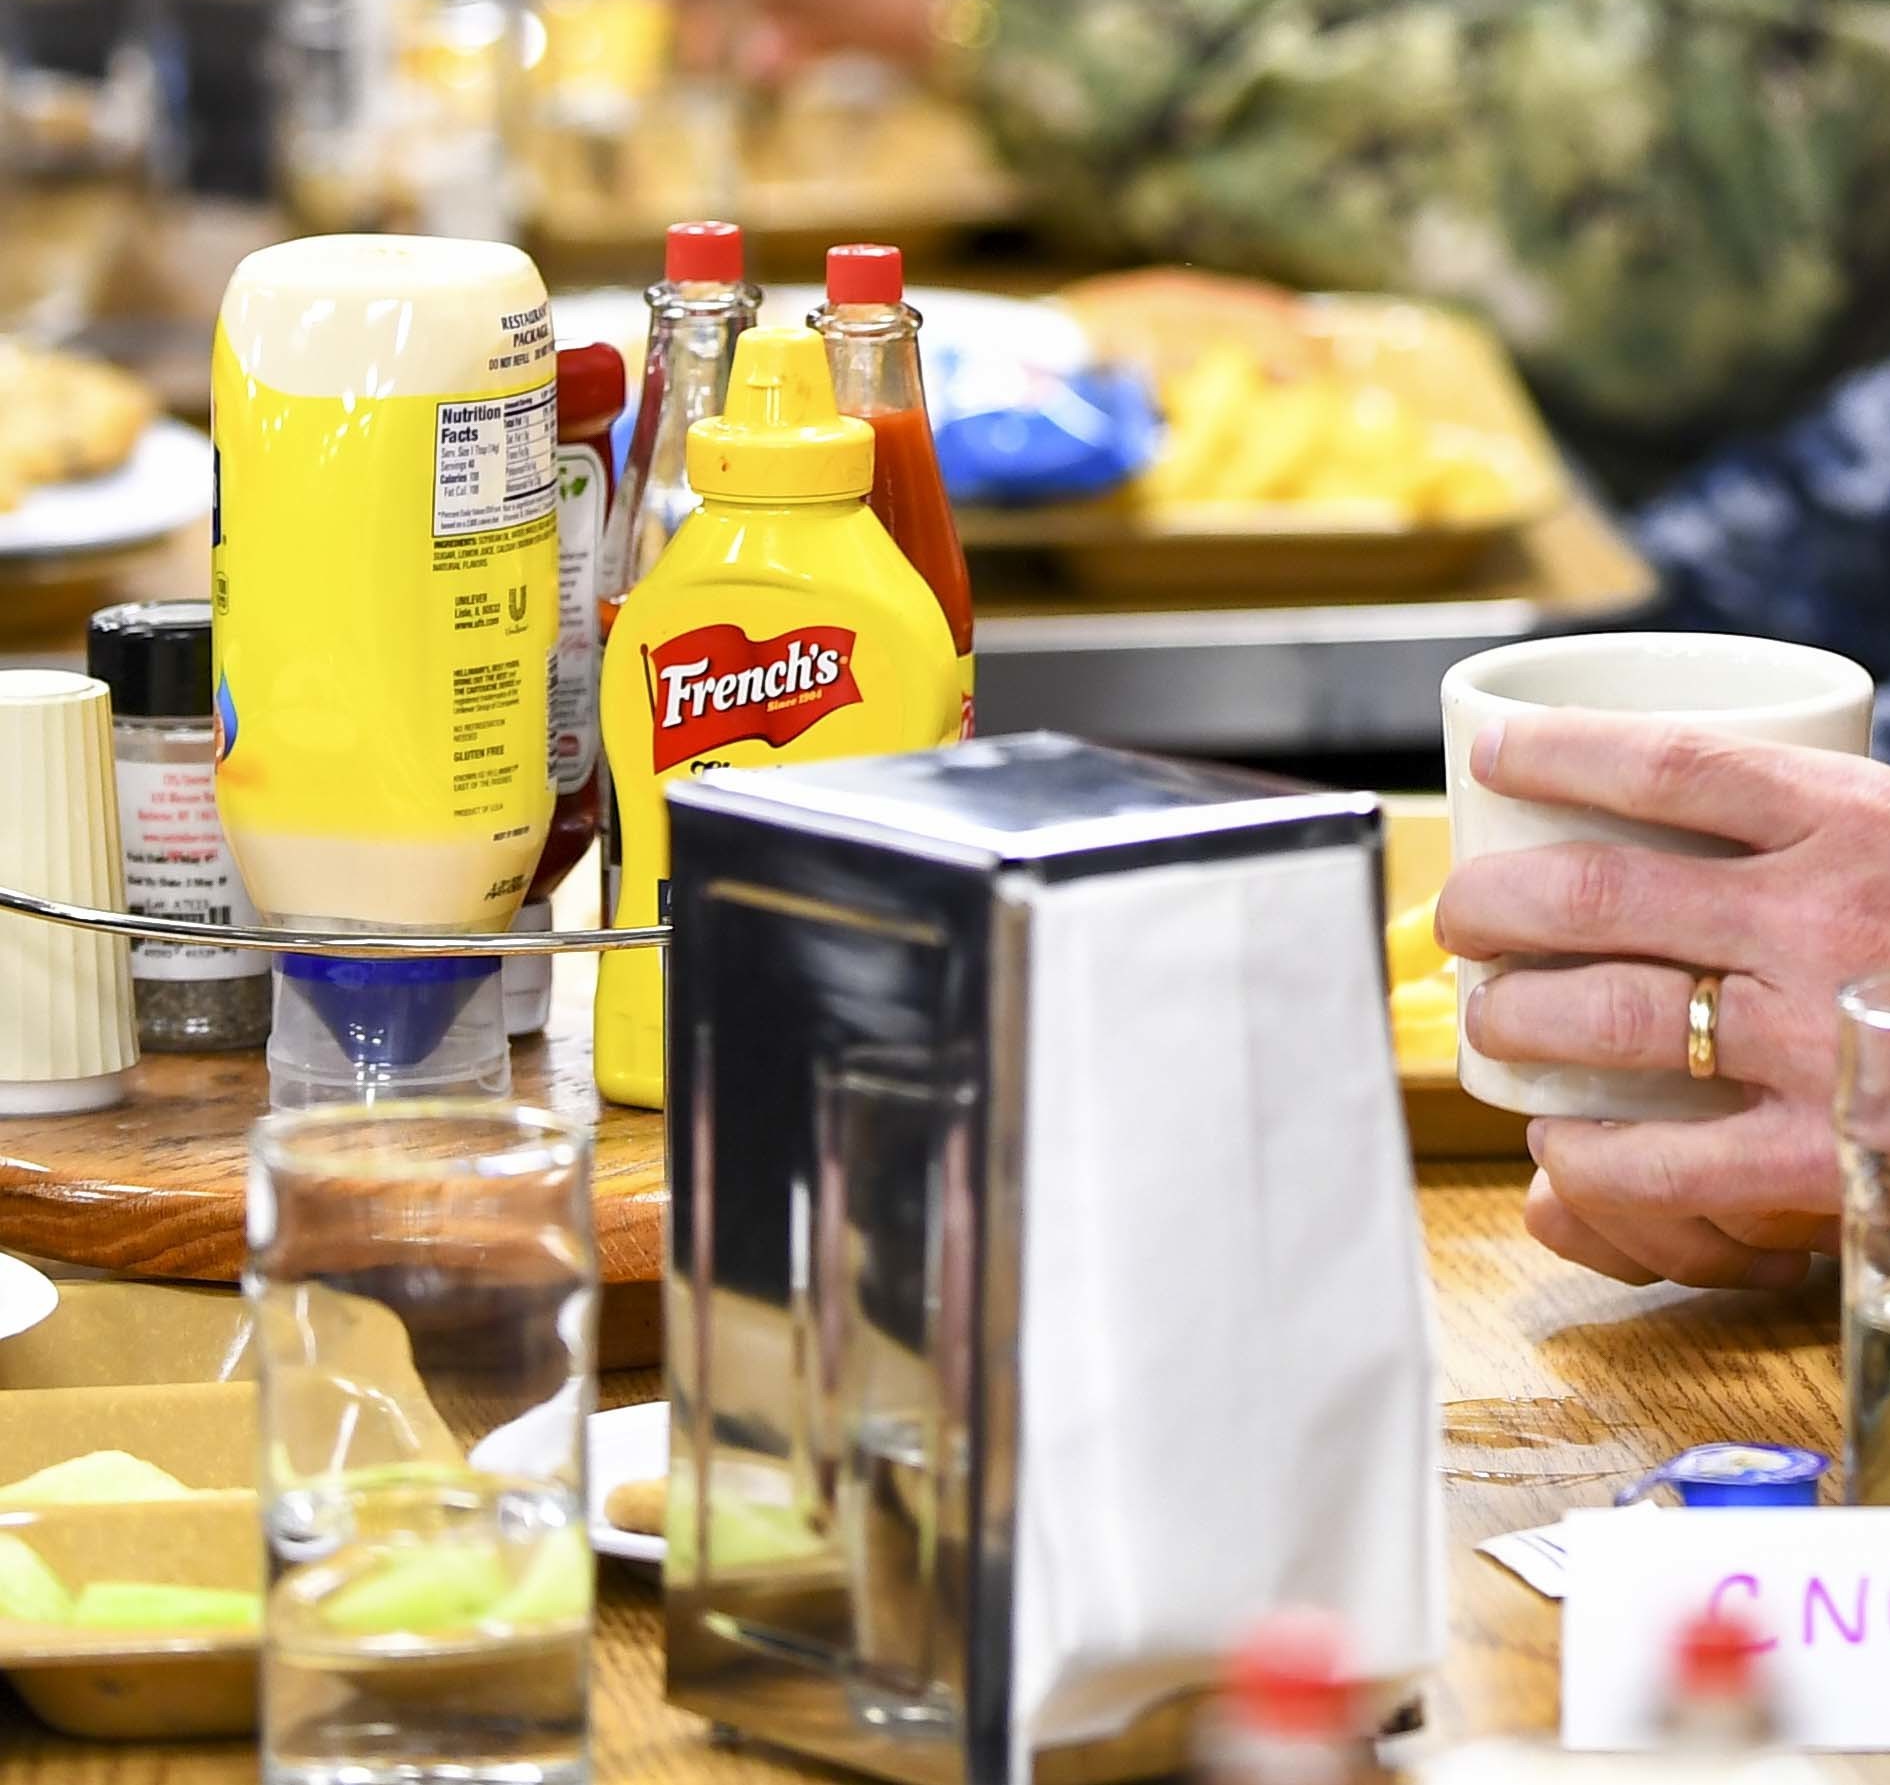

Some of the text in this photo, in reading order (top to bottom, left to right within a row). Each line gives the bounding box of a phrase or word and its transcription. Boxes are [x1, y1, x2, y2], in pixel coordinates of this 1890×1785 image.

[442, 405, 501, 425] Nutrition
[441, 427, 478, 444] Facts
[659, 640, 839, 728] French's
[453, 745, 504, 762] GLUTEN FREE
